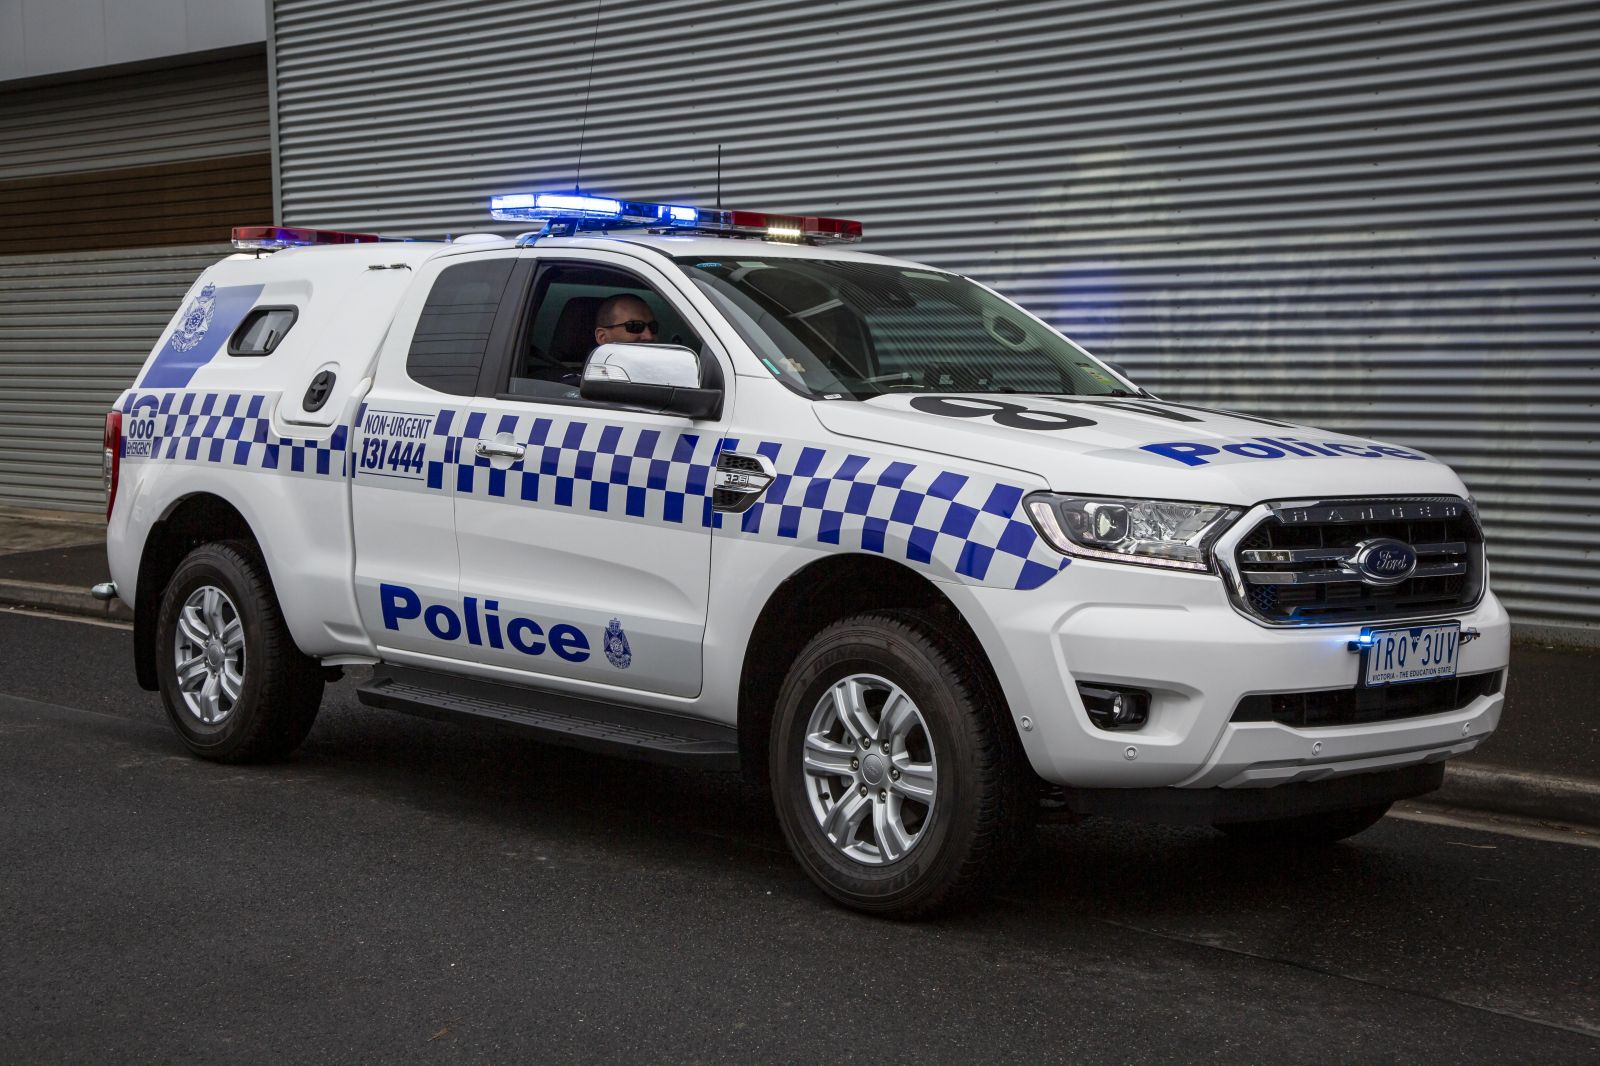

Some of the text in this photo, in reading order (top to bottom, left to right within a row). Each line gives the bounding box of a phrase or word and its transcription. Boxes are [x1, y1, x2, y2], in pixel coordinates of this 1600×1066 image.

[129, 419, 155, 439] 000
[364, 414, 432, 439] NON-URGENT
[126, 441, 152, 455] EMERGENCY
[360, 437, 427, 474] 131 444
[1139, 437, 1427, 467] Police
[1376, 549, 1408, 571] Ford
[380, 583, 591, 663] Police
[1375, 632, 1457, 671] 1RQ 3UV
[1372, 672, 1396, 681] VICTORIA
[1400, 670, 1409, 678] THE
[1409, 668, 1437, 678] EDUCATION
[1437, 666, 1452, 674] STATE
